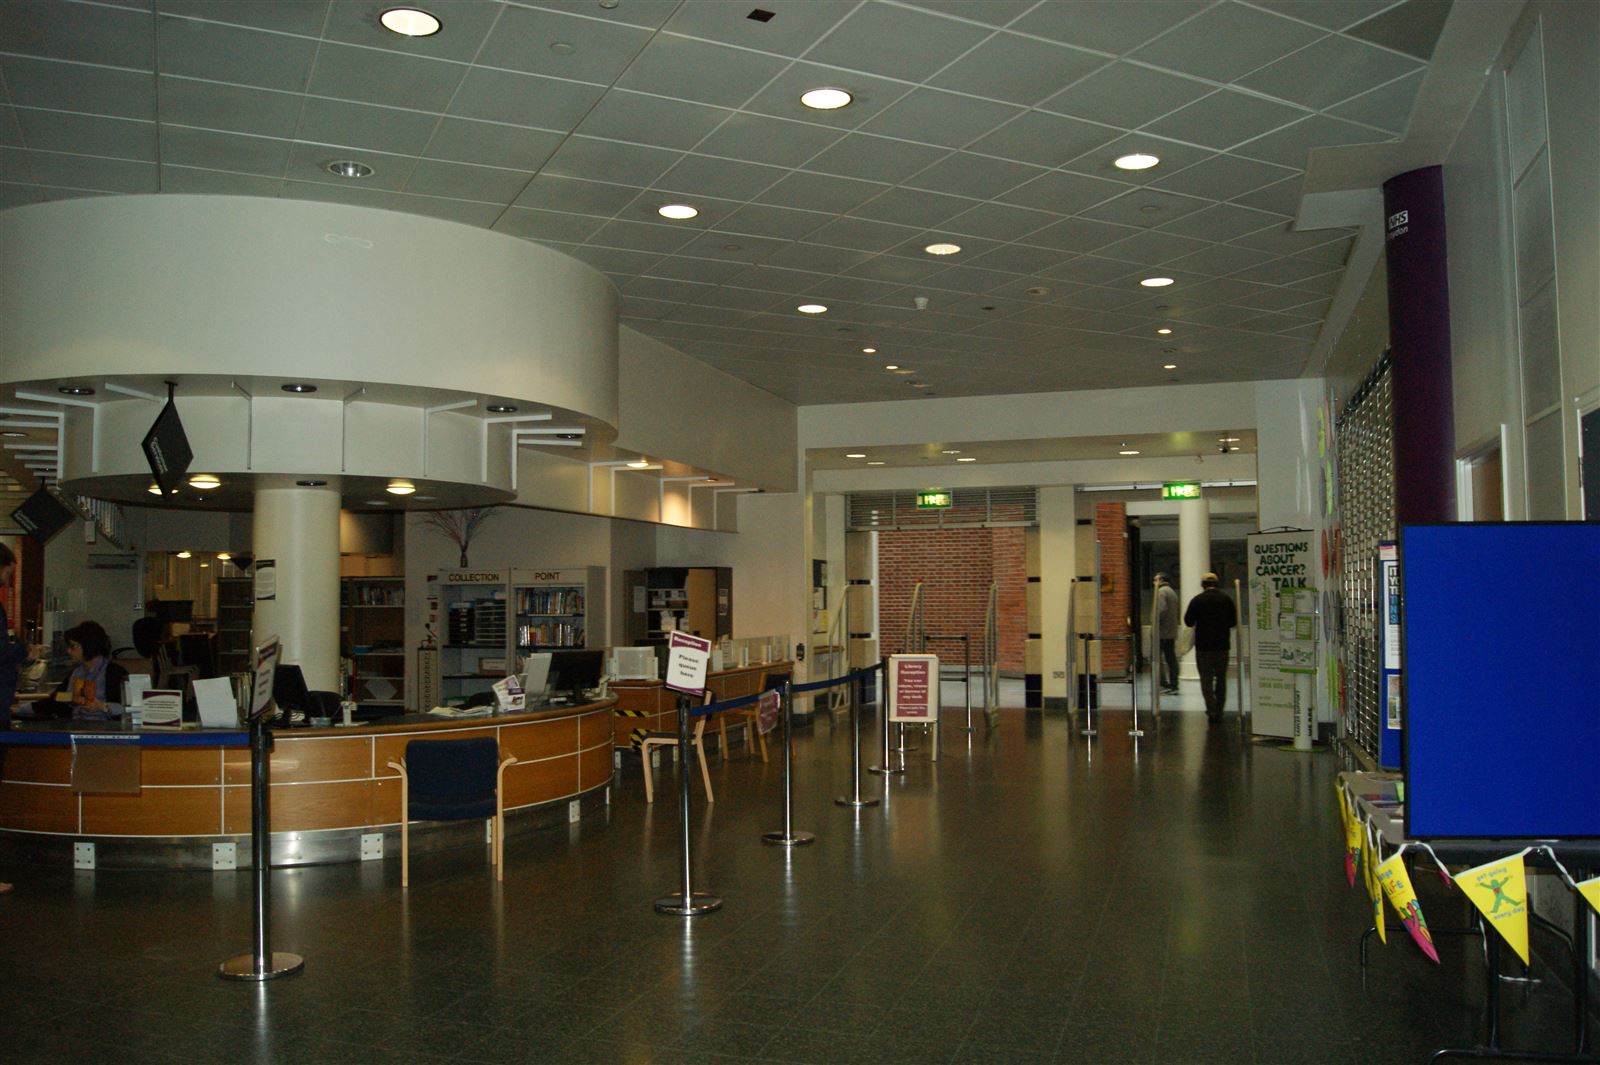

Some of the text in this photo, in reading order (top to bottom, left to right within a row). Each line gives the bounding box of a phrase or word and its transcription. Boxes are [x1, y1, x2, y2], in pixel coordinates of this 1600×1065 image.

[1254, 542, 1308, 554] QUESTIONS
[1260, 553, 1295, 565] ABOUT
[535, 571, 561, 581] POINT
[1256, 564, 1306, 576] CANCER?
[449, 573, 500, 582] COLLECTION
[1272, 577, 1306, 590] TALK
[673, 635, 702, 647] Reception
[679, 654, 699, 663] Please
[679, 663, 697, 671] queue
